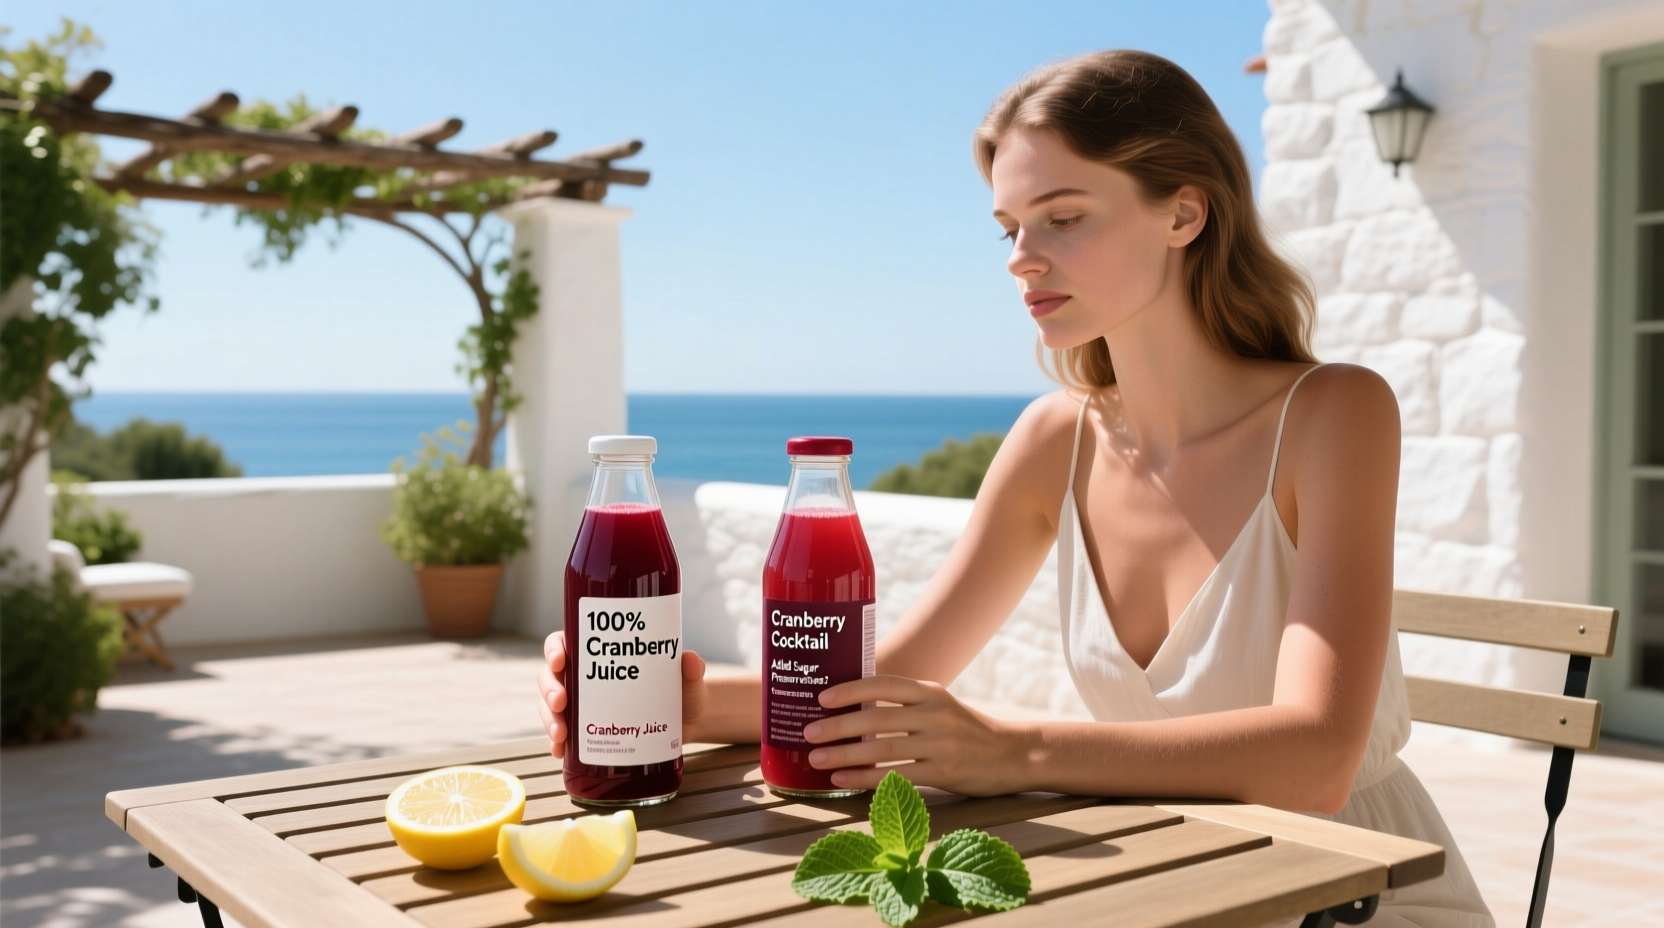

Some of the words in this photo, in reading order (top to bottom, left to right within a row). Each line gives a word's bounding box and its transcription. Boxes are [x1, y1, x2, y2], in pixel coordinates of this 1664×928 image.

[586, 611, 646, 632] 100%
[771, 609, 846, 633] Cranberry
[586, 636, 679, 660] Cranberry
[771, 630, 829, 650] Cocktail
[586, 659, 640, 681] Juice
